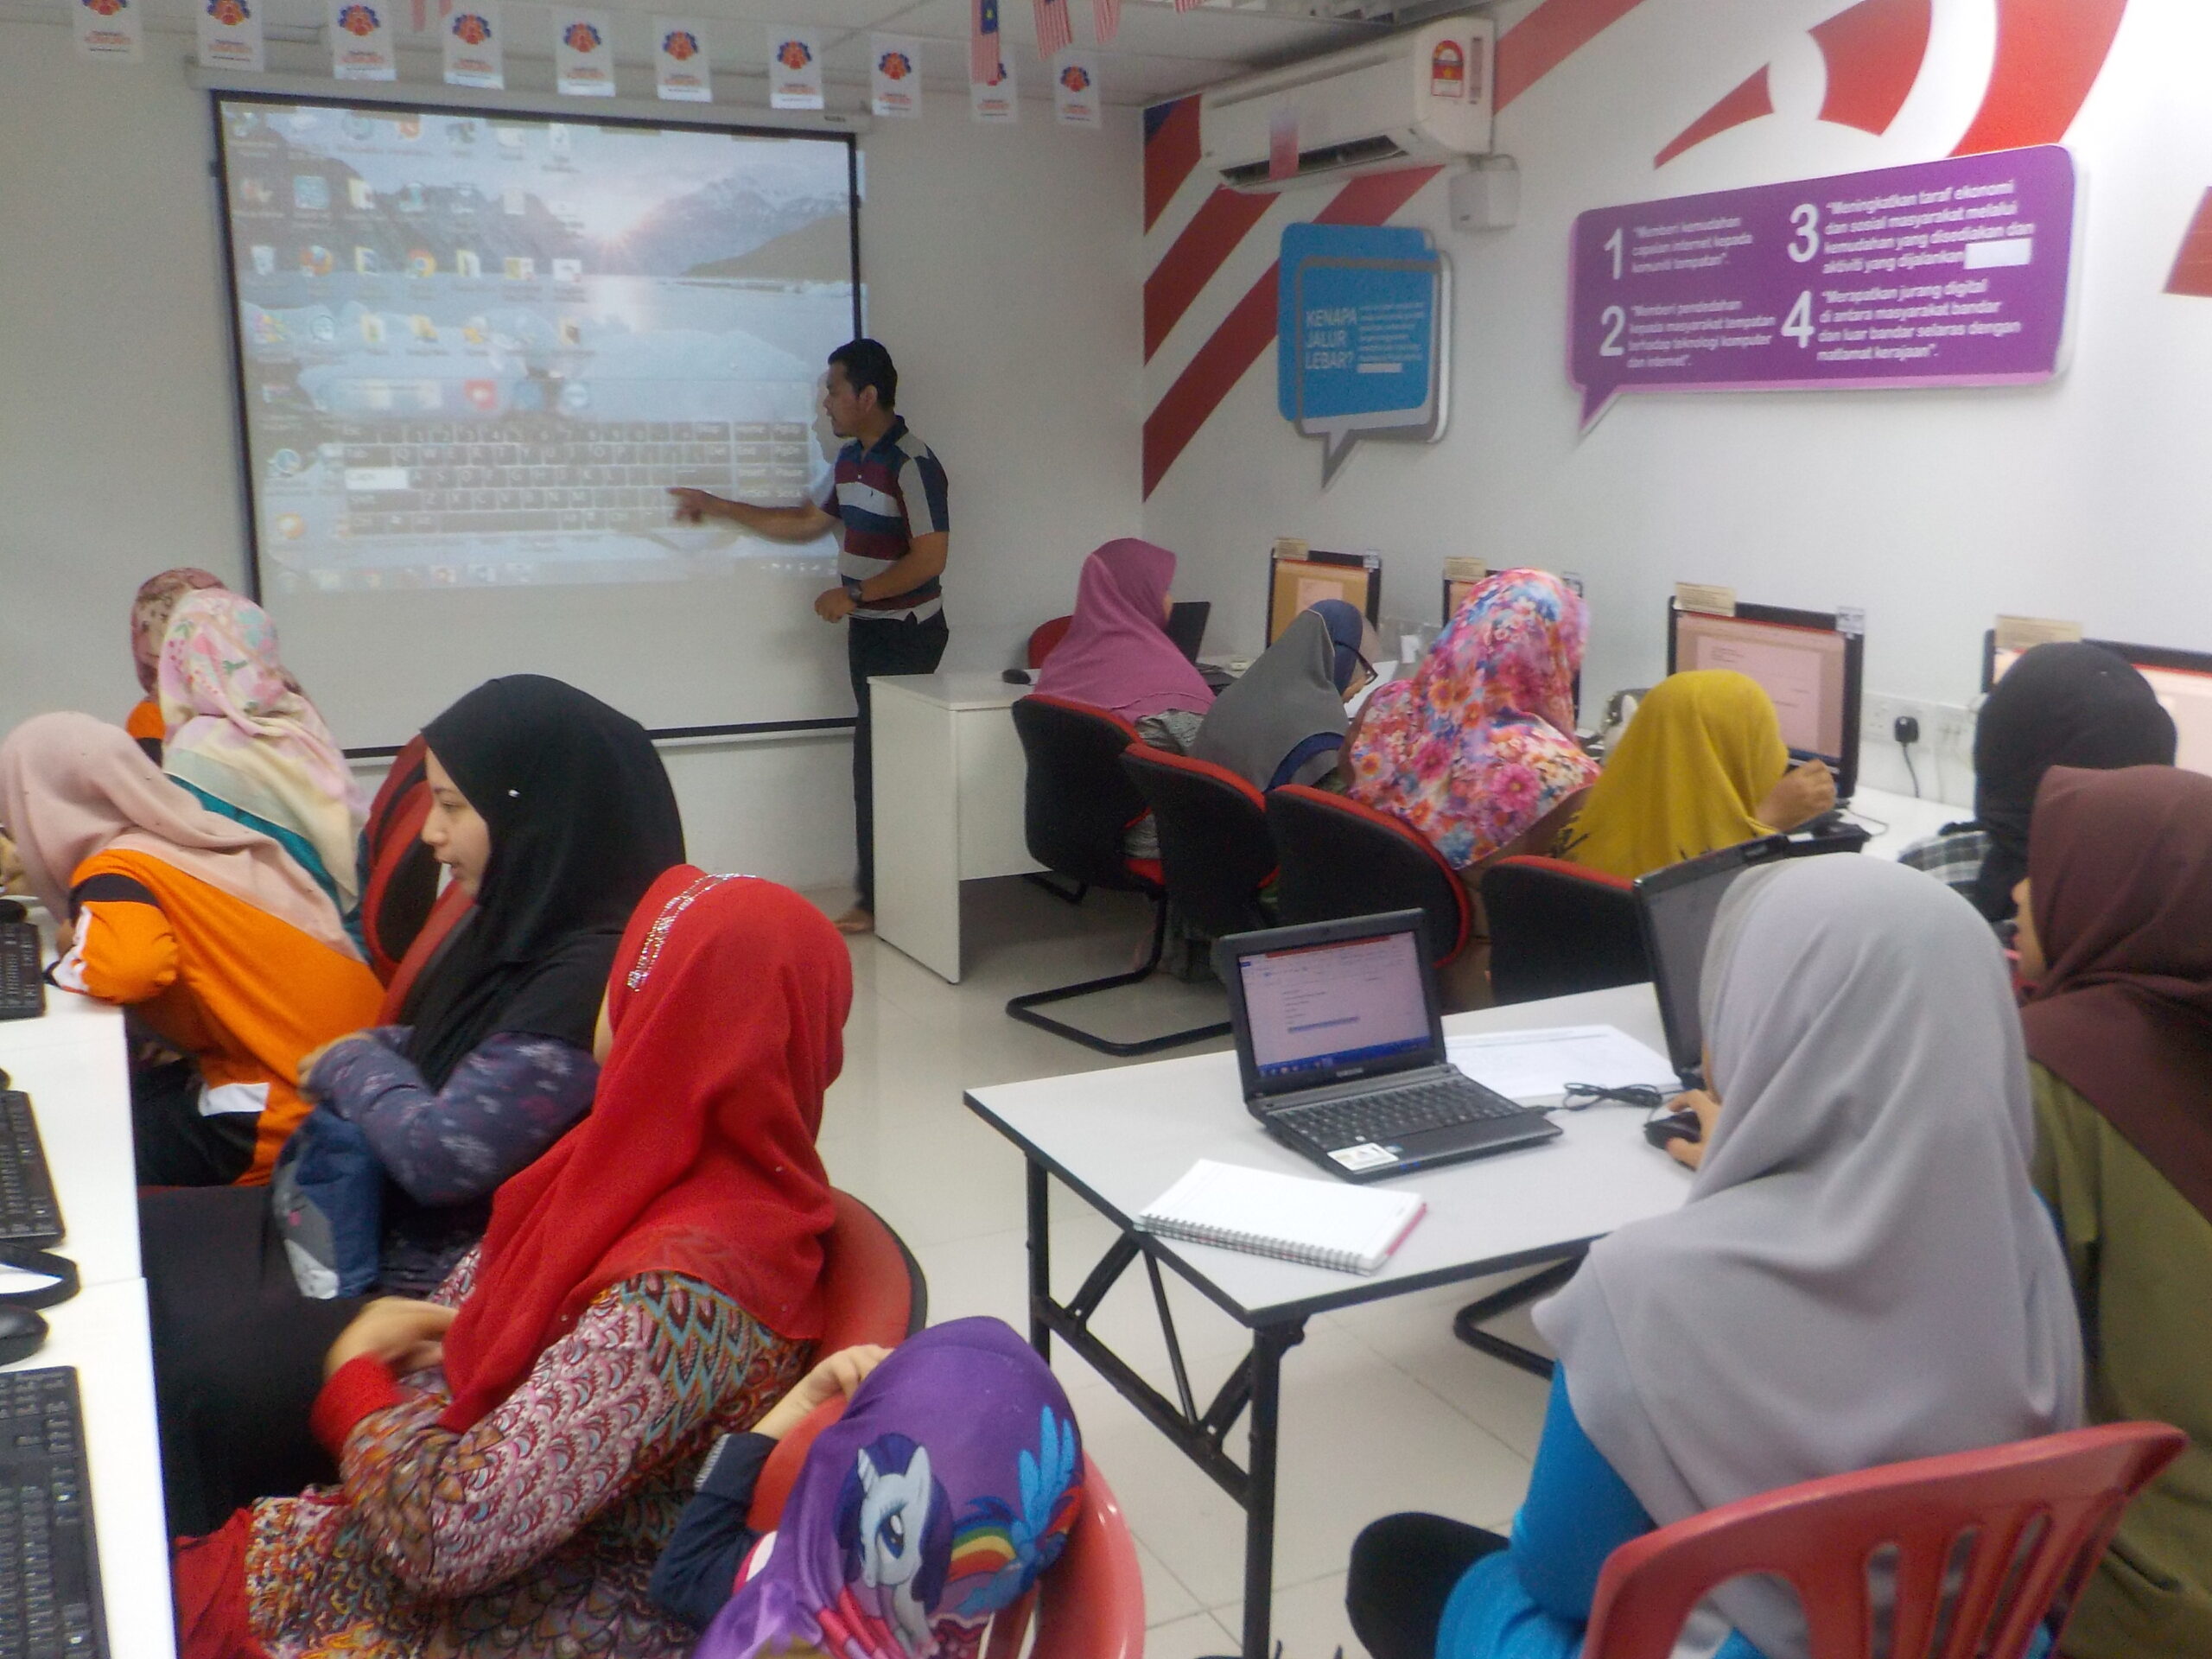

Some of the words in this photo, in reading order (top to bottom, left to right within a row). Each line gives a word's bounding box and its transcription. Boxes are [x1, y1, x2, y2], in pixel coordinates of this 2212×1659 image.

[1604, 227, 1624, 281] 1
[1788, 203, 1820, 263] 3
[1306, 329, 1349, 348] JALUR
[1600, 304, 1627, 357] 2
[1781, 289, 1815, 349] 4
